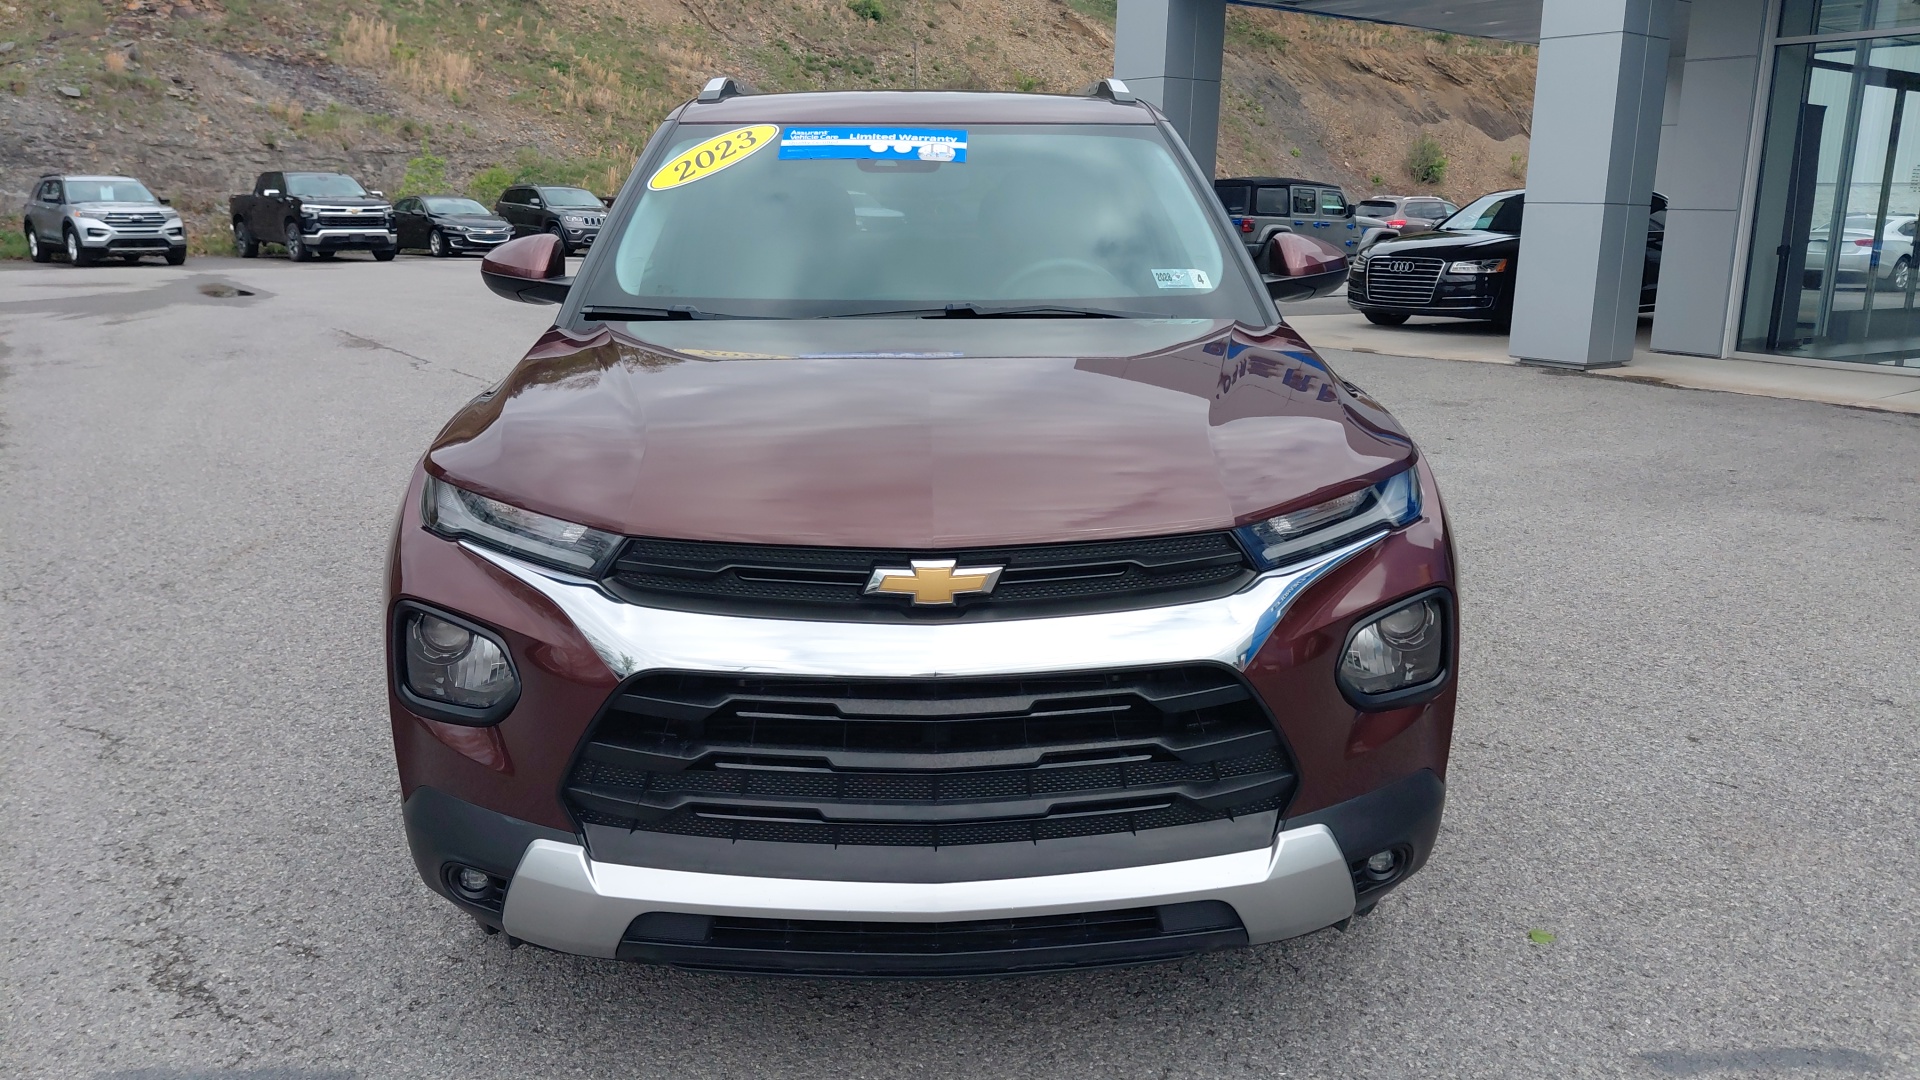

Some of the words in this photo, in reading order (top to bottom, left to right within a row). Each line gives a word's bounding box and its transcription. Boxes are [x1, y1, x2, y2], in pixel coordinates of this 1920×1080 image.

[849, 133, 896, 141] Limited
[898, 133, 958, 143] Warranty
[674, 130, 757, 182] 2023
[1197, 274, 1204, 284] 4
